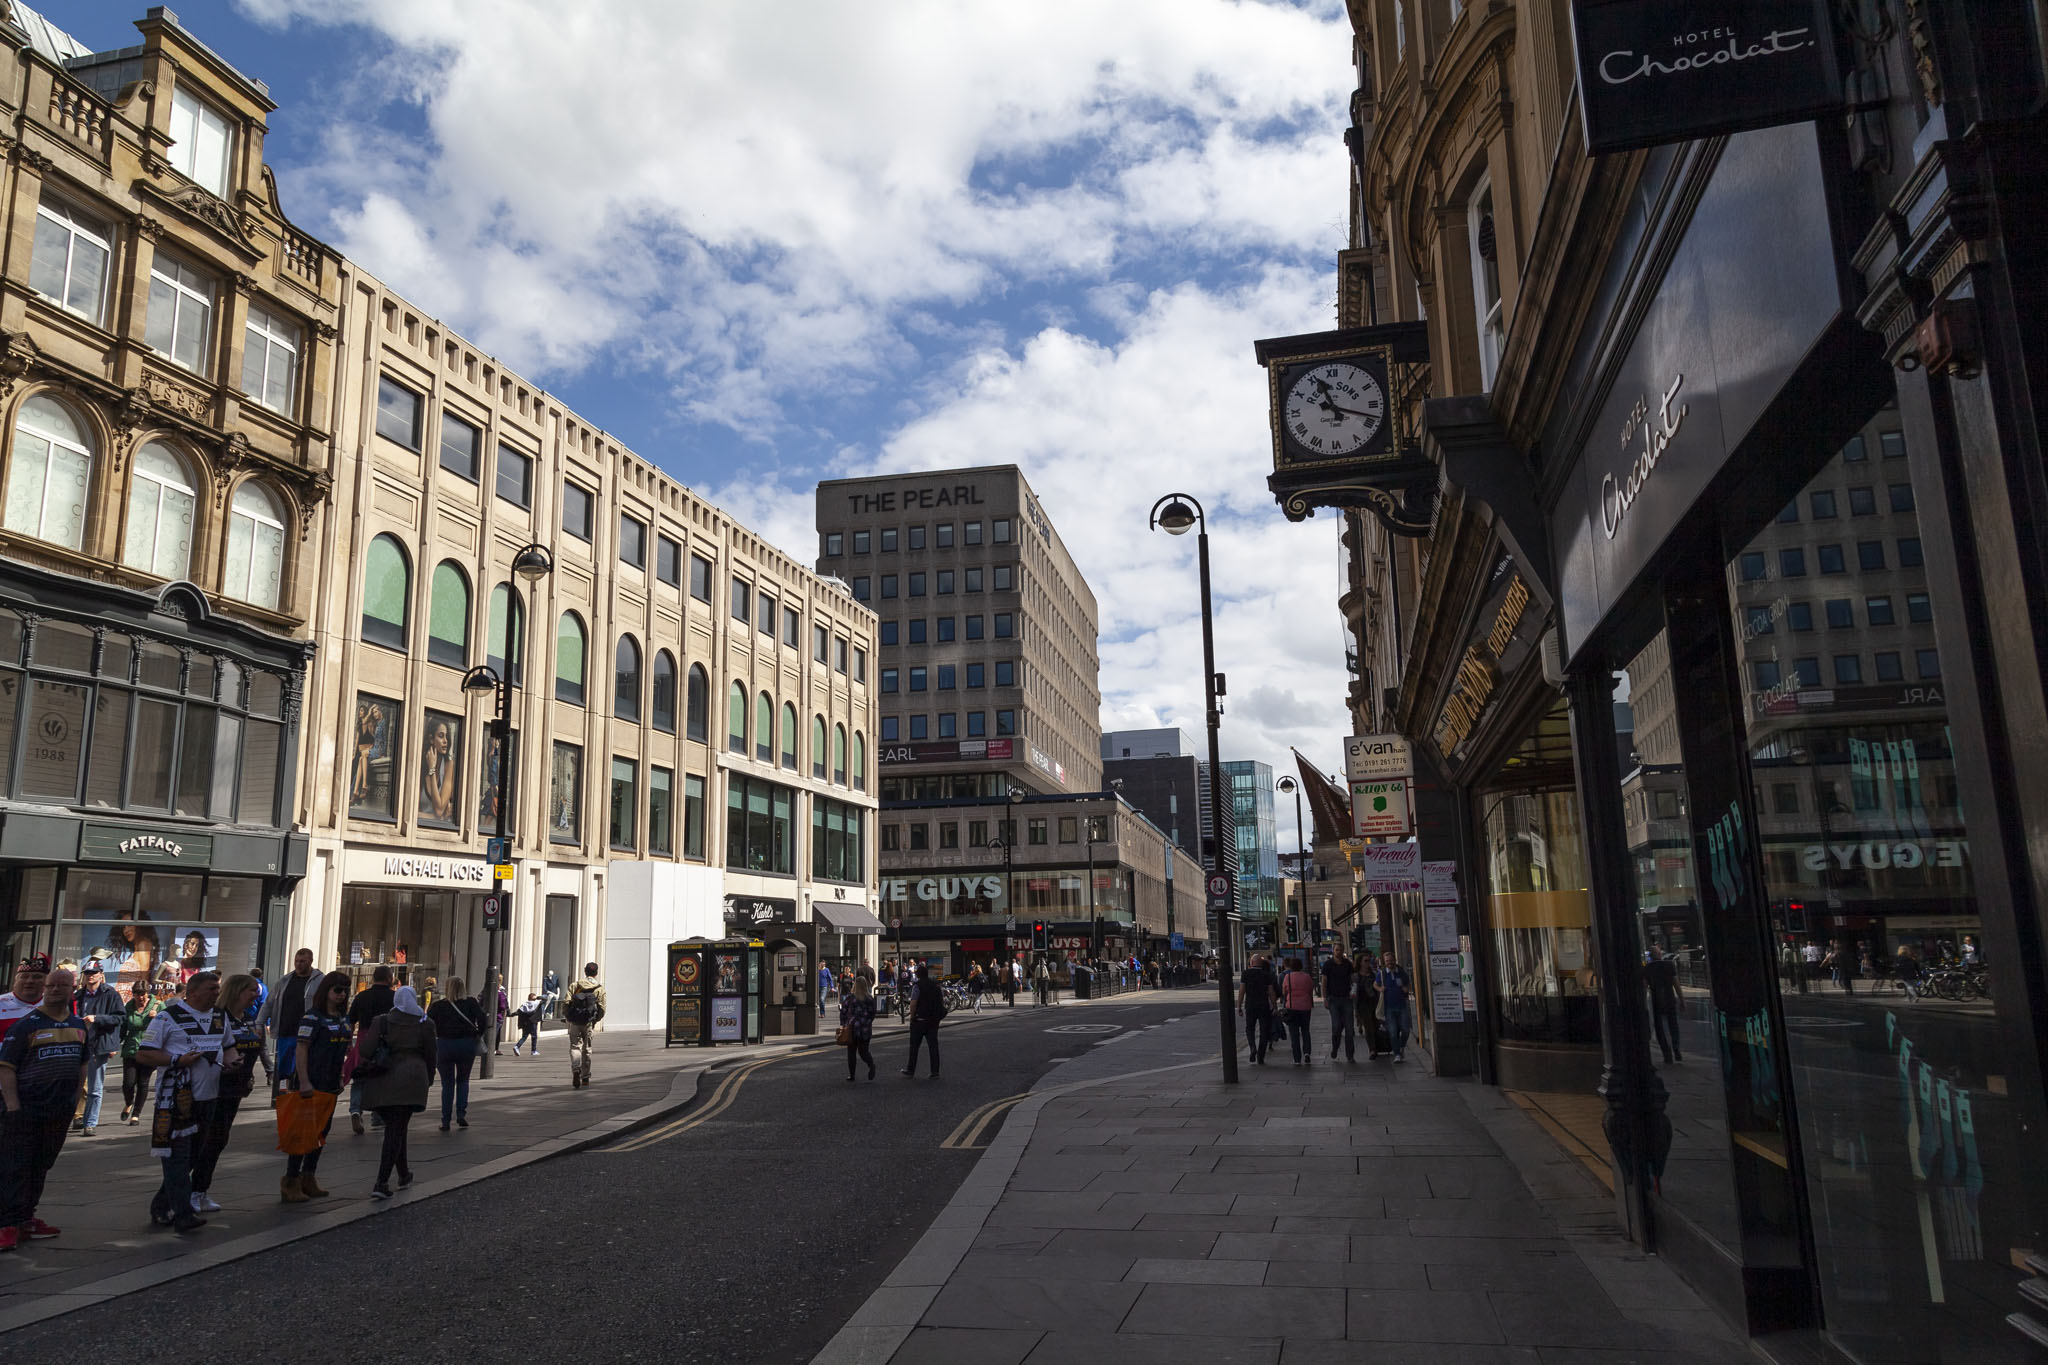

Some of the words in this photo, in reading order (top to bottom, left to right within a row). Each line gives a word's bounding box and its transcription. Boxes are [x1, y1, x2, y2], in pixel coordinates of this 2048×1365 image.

[1673, 26, 1736, 46] HOTEL
[1336, 381, 1359, 400] SONS
[1620, 393, 1649, 451] HOTEL
[848, 491, 896, 514] THE
[903, 485, 985, 510] PEARL
[1488, 575, 1529, 659] SILVERSMITHS
[1458, 646, 1494, 707] SONS
[34, 748, 65, 761] 1988
[878, 747, 918, 762] EARL
[1350, 741, 1393, 757] e'van
[1391, 783, 1403, 792] 66
[119, 835, 183, 858] FATFACE
[1373, 844, 1416, 867] Trendy
[268, 863, 276, 871] 10
[384, 857, 445, 880] MICHAEL
[449, 863, 485, 882] KORS
[917, 876, 1002, 901] GUYS
[1369, 883, 1384, 893] JUST
[1385, 882, 1402, 892] WALK
[1402, 881, 1410, 891] IN
[751, 902, 775, 921] Kiehl's
